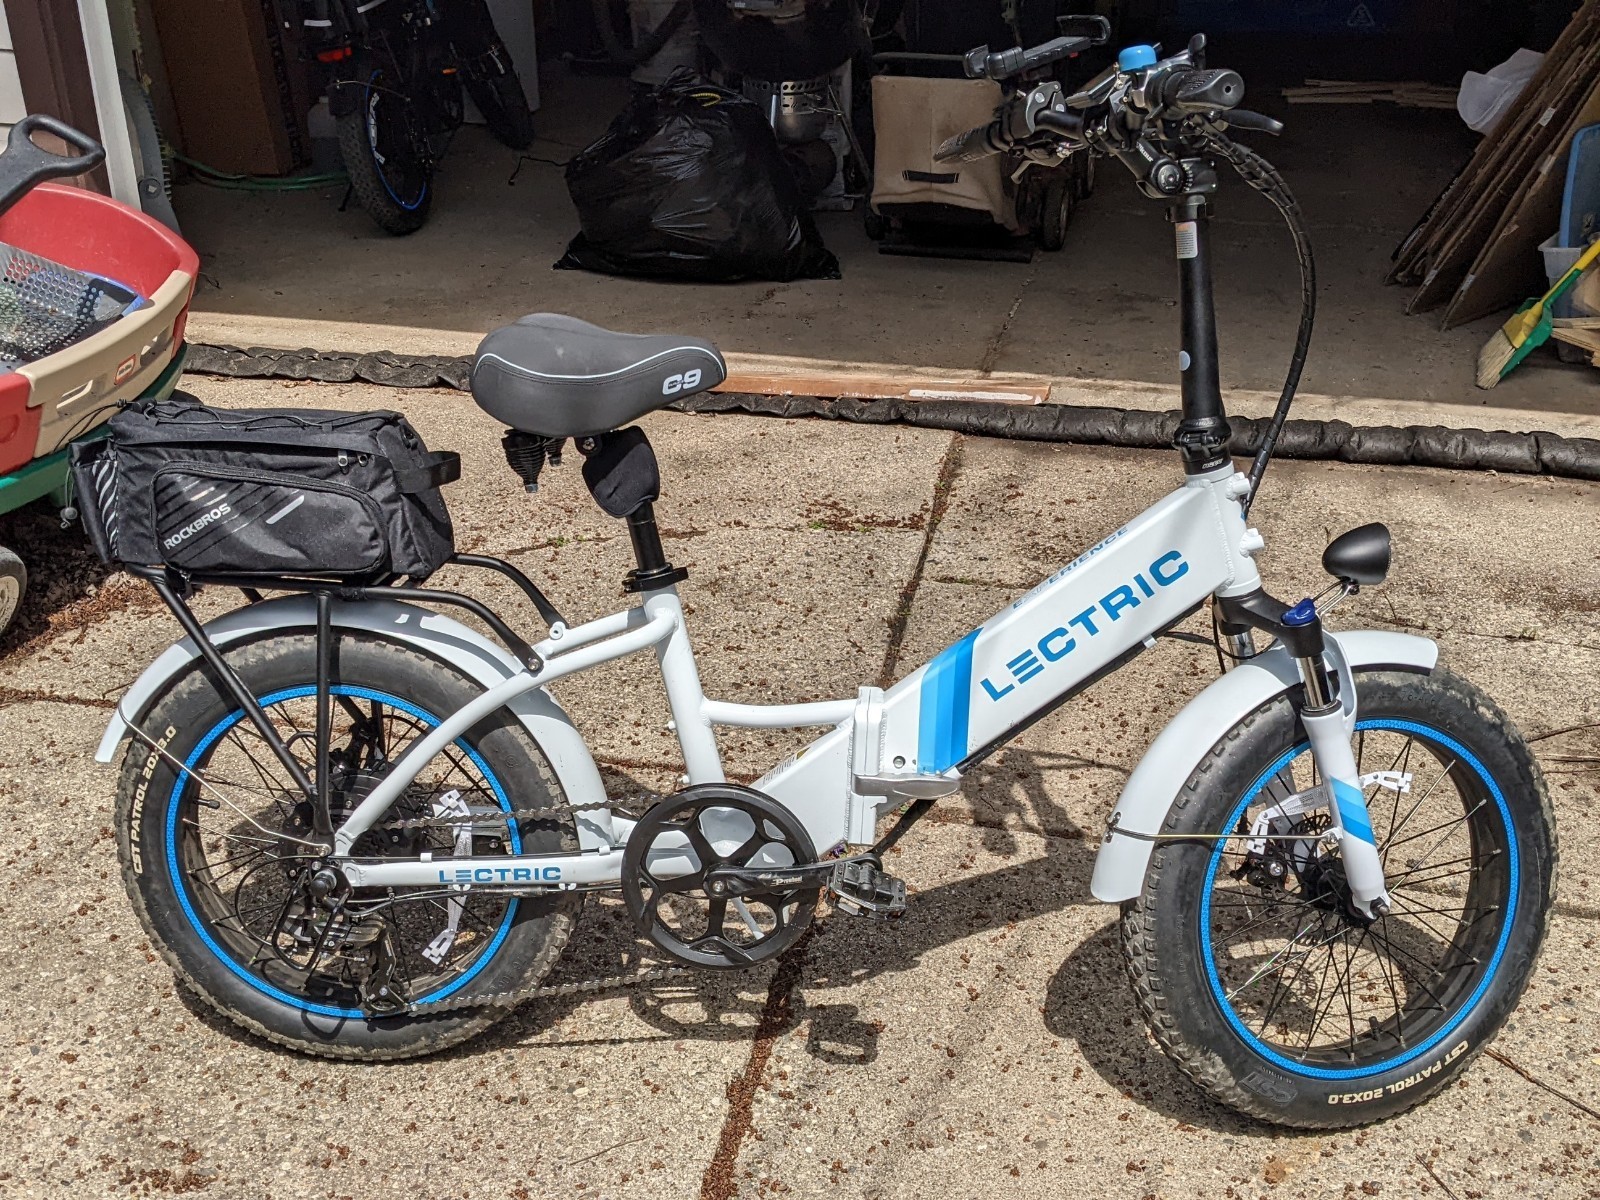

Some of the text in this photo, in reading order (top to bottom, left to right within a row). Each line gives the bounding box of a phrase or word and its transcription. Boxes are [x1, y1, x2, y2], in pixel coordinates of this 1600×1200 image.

[662, 368, 702, 395] C9
[163, 503, 231, 550] ROCKBROS
[980, 550, 1189, 702] LECTRIC
[131, 781, 148, 841] PATROL
[130, 843, 143, 874] CST
[439, 867, 561, 883] LECTRIC
[1328, 1040, 1469, 1105] CST PATROL 20X3.0
